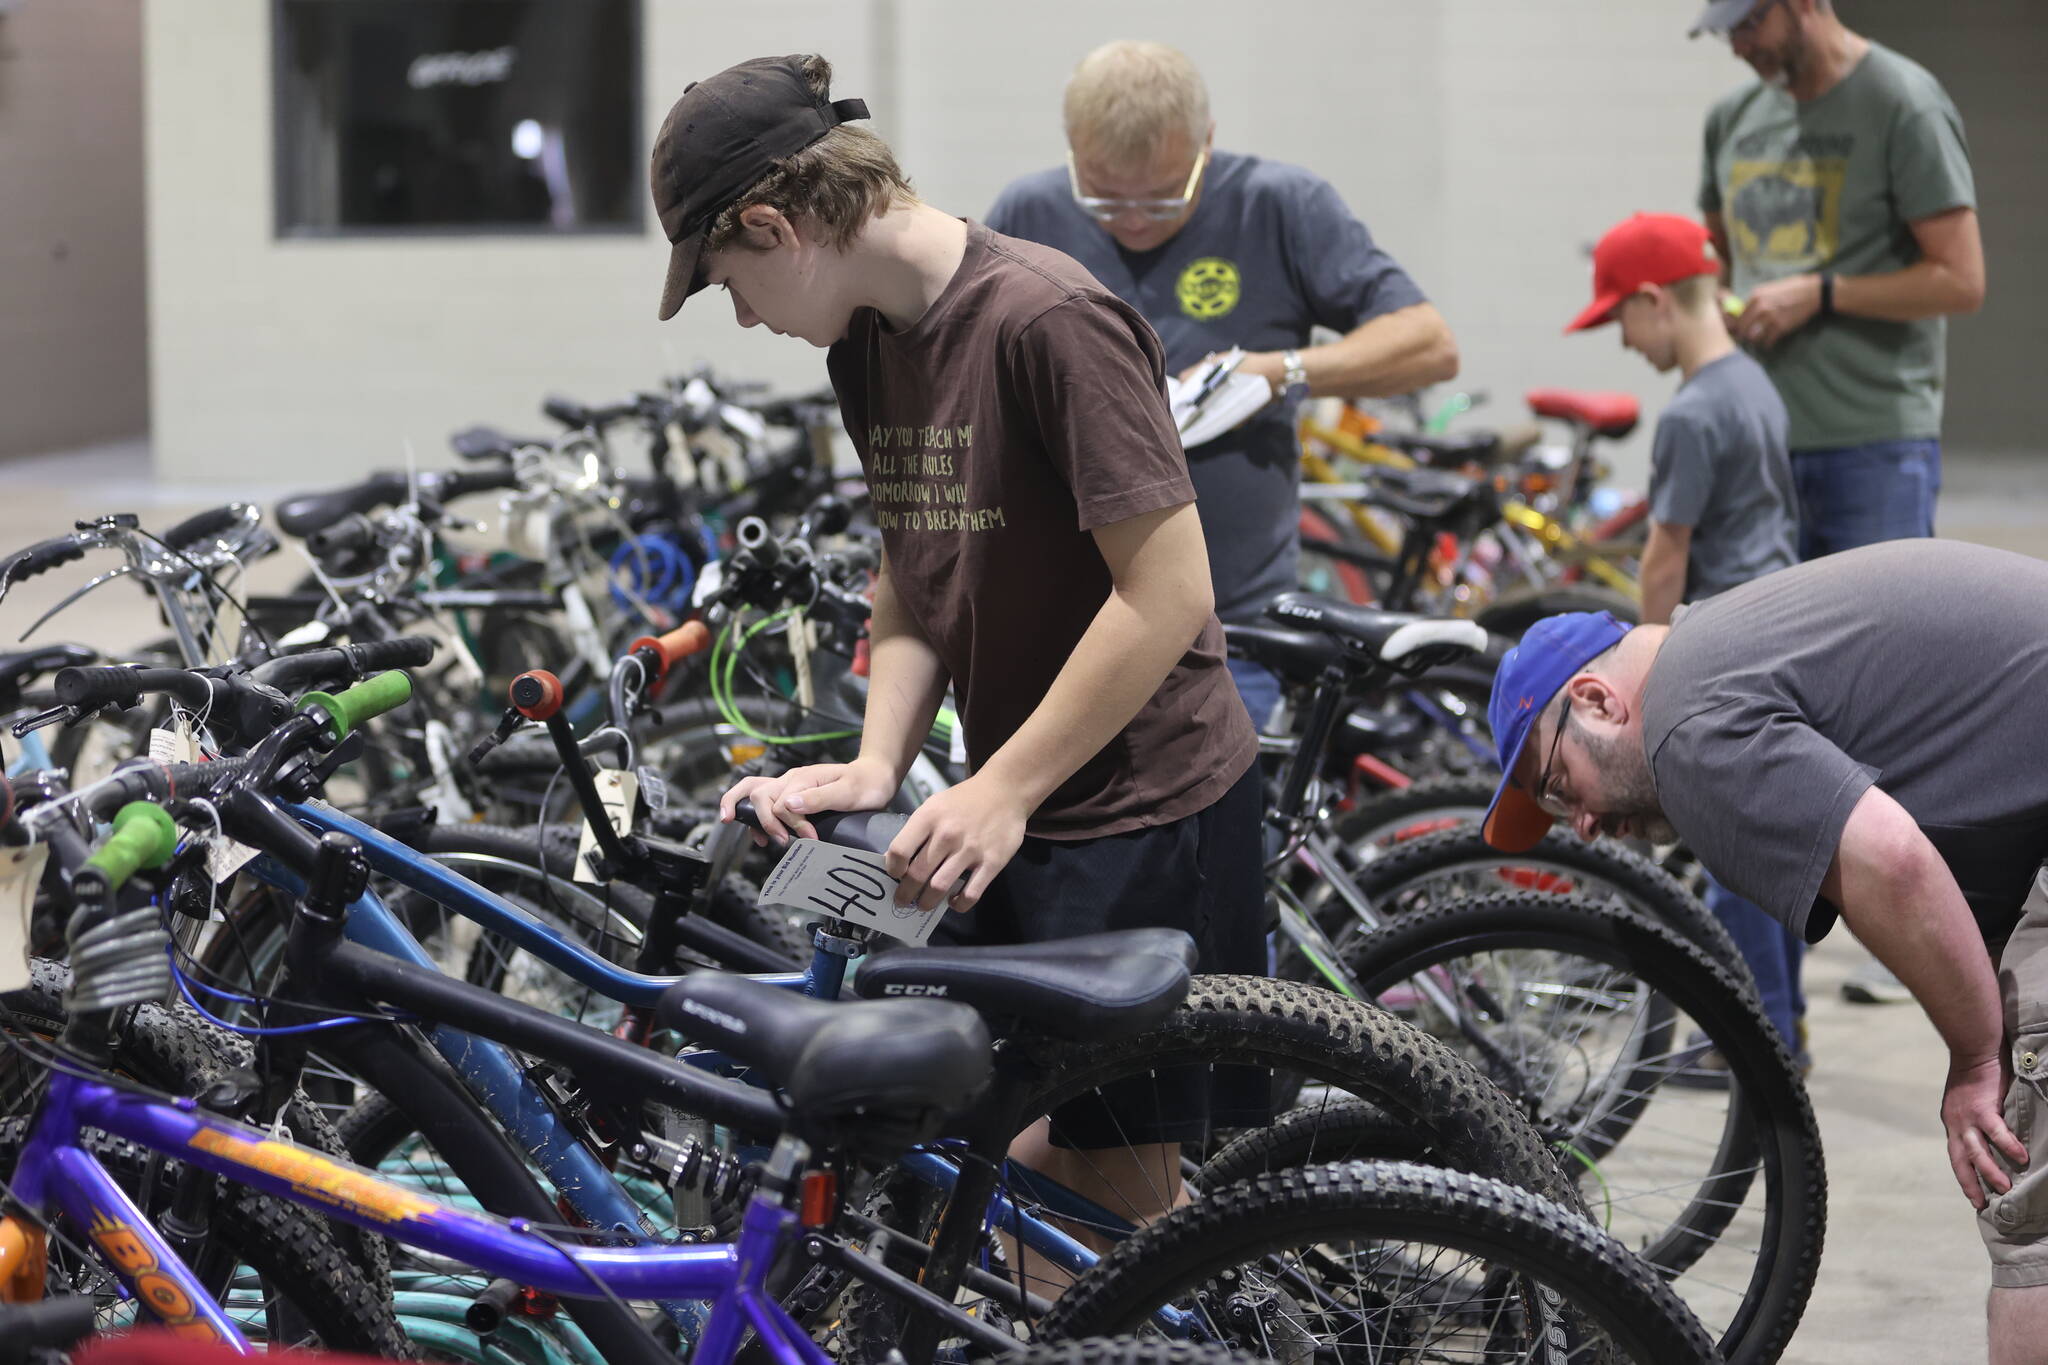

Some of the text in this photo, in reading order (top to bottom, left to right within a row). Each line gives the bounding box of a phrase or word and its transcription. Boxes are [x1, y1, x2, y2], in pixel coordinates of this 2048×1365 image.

[918, 425, 952, 448] TEACH
[873, 452, 954, 476] ALL THE RULES
[904, 511, 920, 530] TO
[808, 854, 901, 917] 401
[884, 984, 948, 997] CCM
